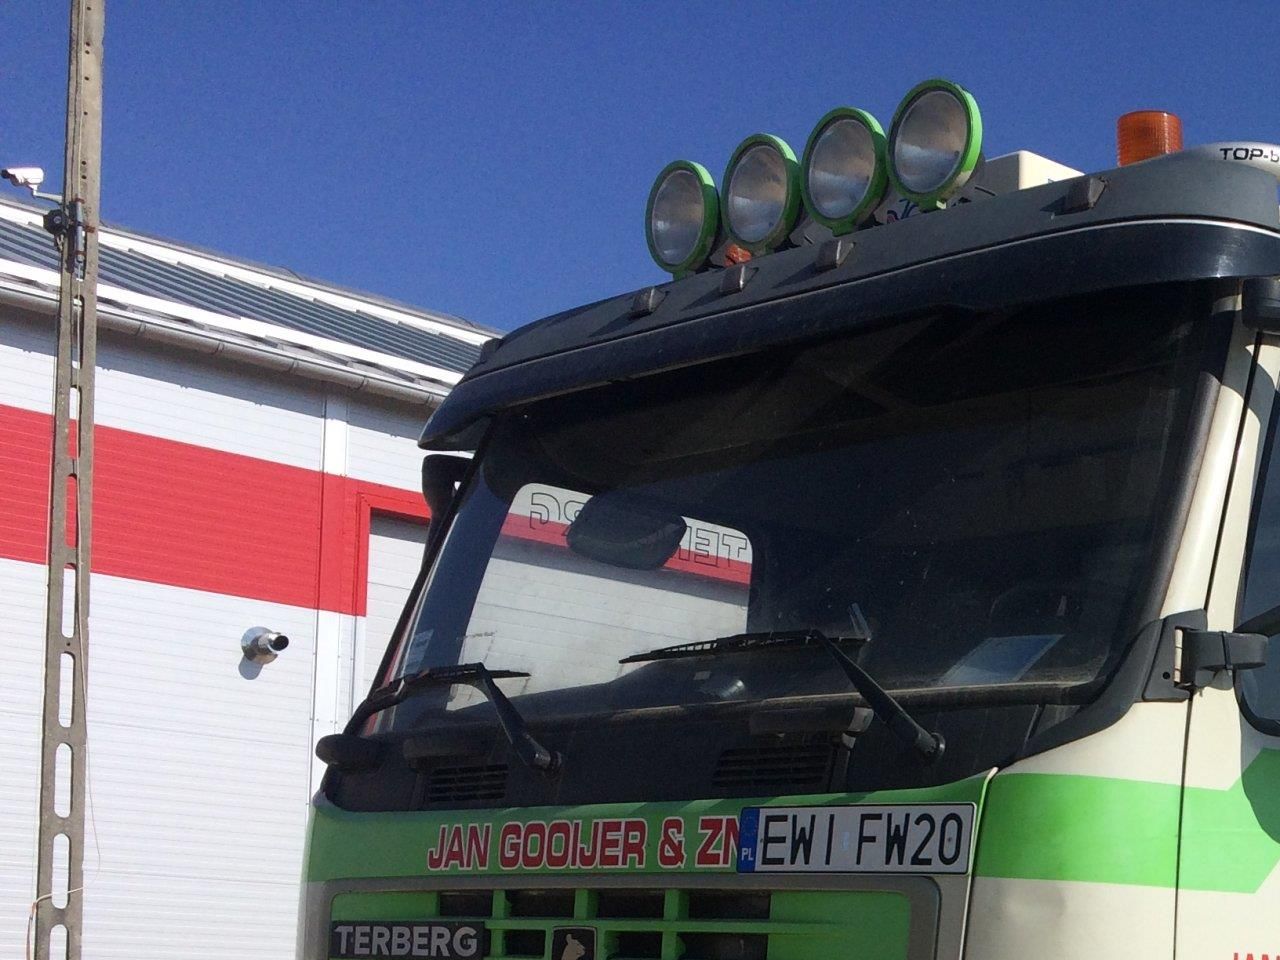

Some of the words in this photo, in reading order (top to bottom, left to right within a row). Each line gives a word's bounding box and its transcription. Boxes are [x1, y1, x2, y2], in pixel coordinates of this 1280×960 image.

[427, 823, 492, 871] JAN
[500, 818, 647, 869] GOOIJER
[658, 816, 686, 869] &
[741, 847, 754, 862] PL
[855, 812, 964, 866] FW20
[334, 924, 478, 957] TERBERG
